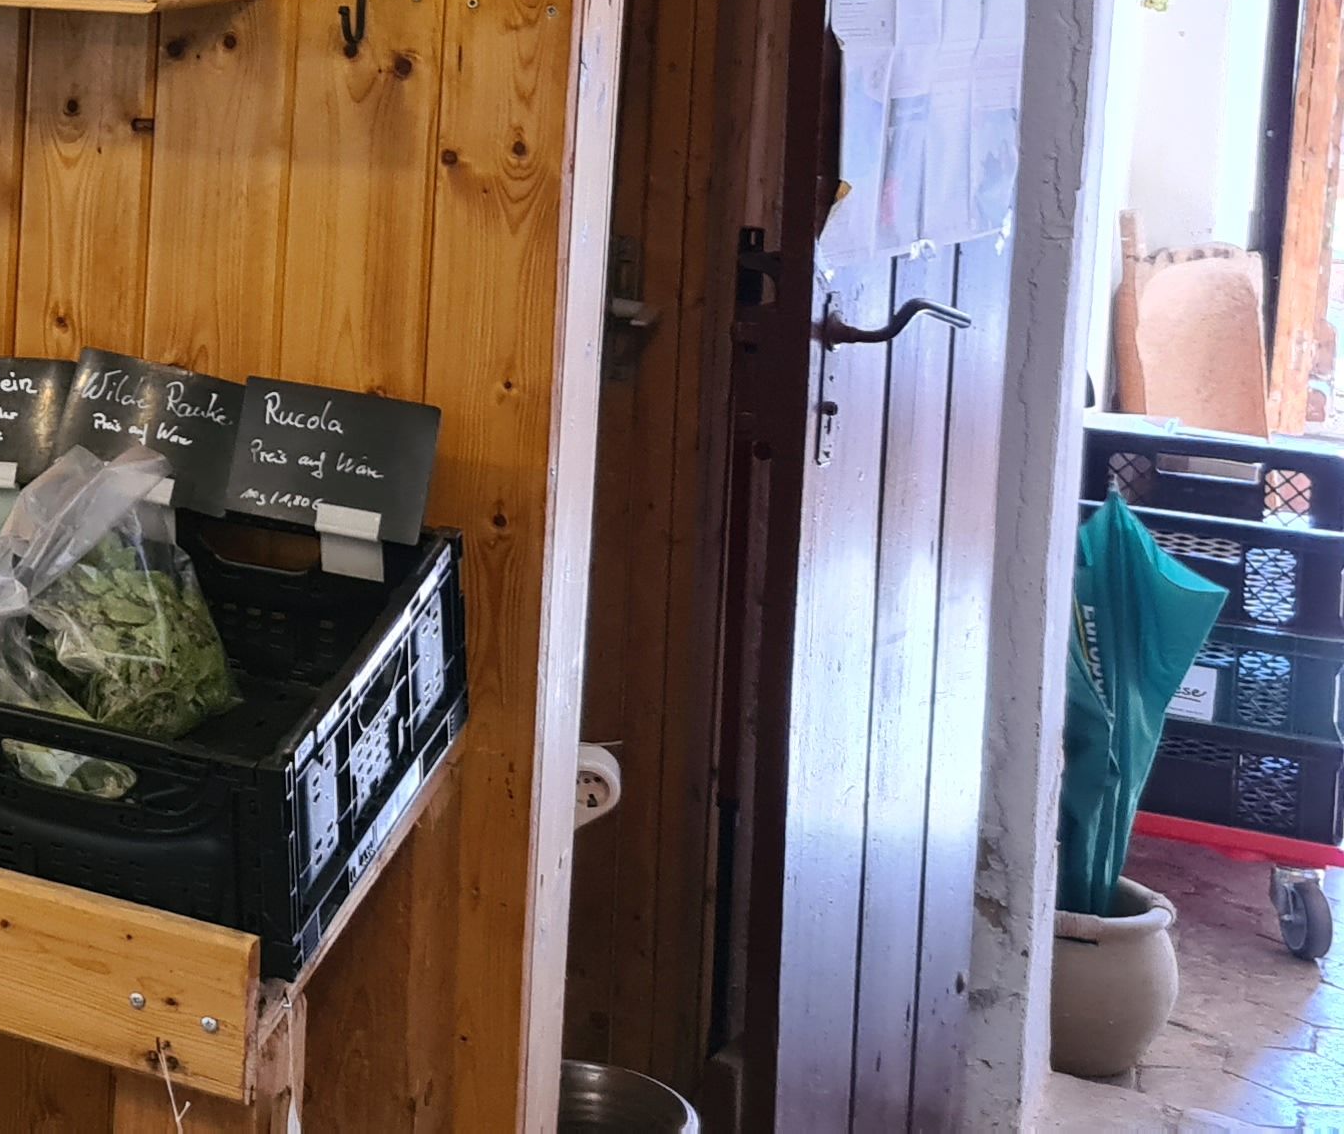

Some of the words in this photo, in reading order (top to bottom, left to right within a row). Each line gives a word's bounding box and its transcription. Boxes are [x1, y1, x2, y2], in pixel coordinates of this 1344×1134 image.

[80, 370, 151, 410] Wilde
[93, 412, 122, 433] Preis
[156, 423, 193, 446] Ware
[263, 391, 344, 435] Rucola
[250, 439, 288, 465] Preis
[297, 451, 325, 480] auf
[335, 451, 385, 480] Ware
